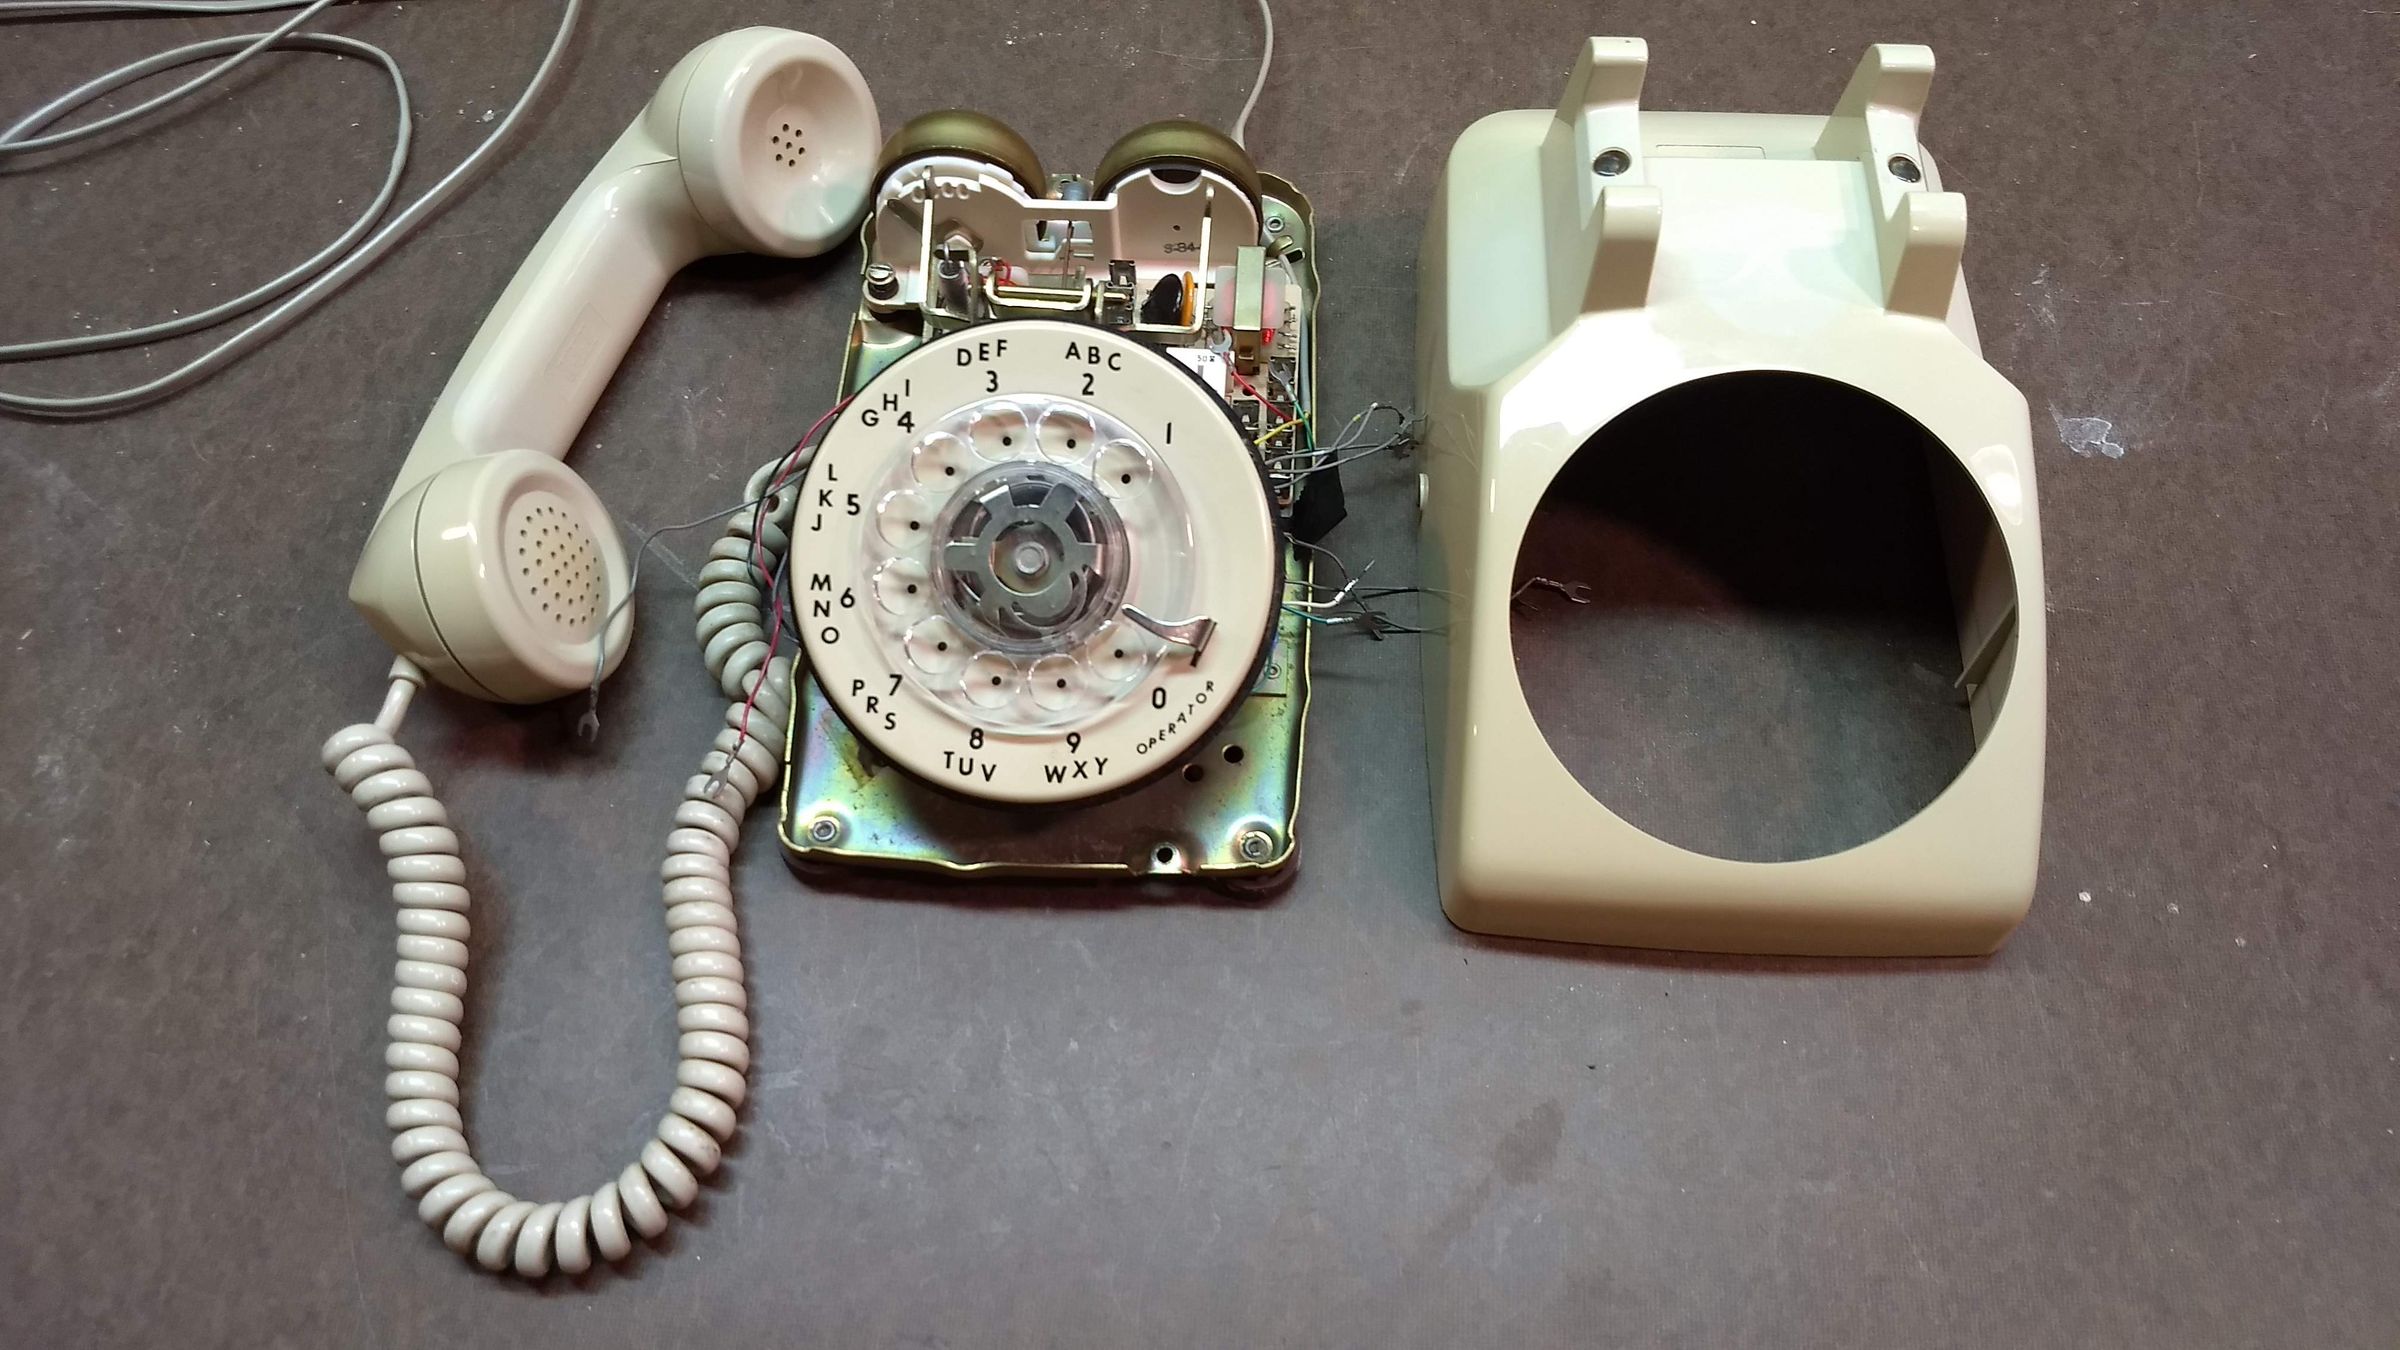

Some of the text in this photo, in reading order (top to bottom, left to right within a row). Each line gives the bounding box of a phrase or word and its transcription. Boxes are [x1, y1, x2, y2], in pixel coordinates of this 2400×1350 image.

[956, 339, 1008, 367] DEF
[1066, 341, 1121, 372] ABC
[986, 370, 999, 393] 3
[1081, 372, 1095, 396] 2
[897, 410, 915, 434] 4
[847, 493, 861, 516] 5
[840, 587, 856, 610] 6
[888, 674, 903, 698] 7
[851, 680, 897, 731] PRS
[1136, 680, 1214, 755] OPERATOR
[969, 727, 985, 750] 8
[1066, 732, 1082, 755] 9
[943, 750, 997, 782] TUV
[1044, 757, 1109, 784] WXY
